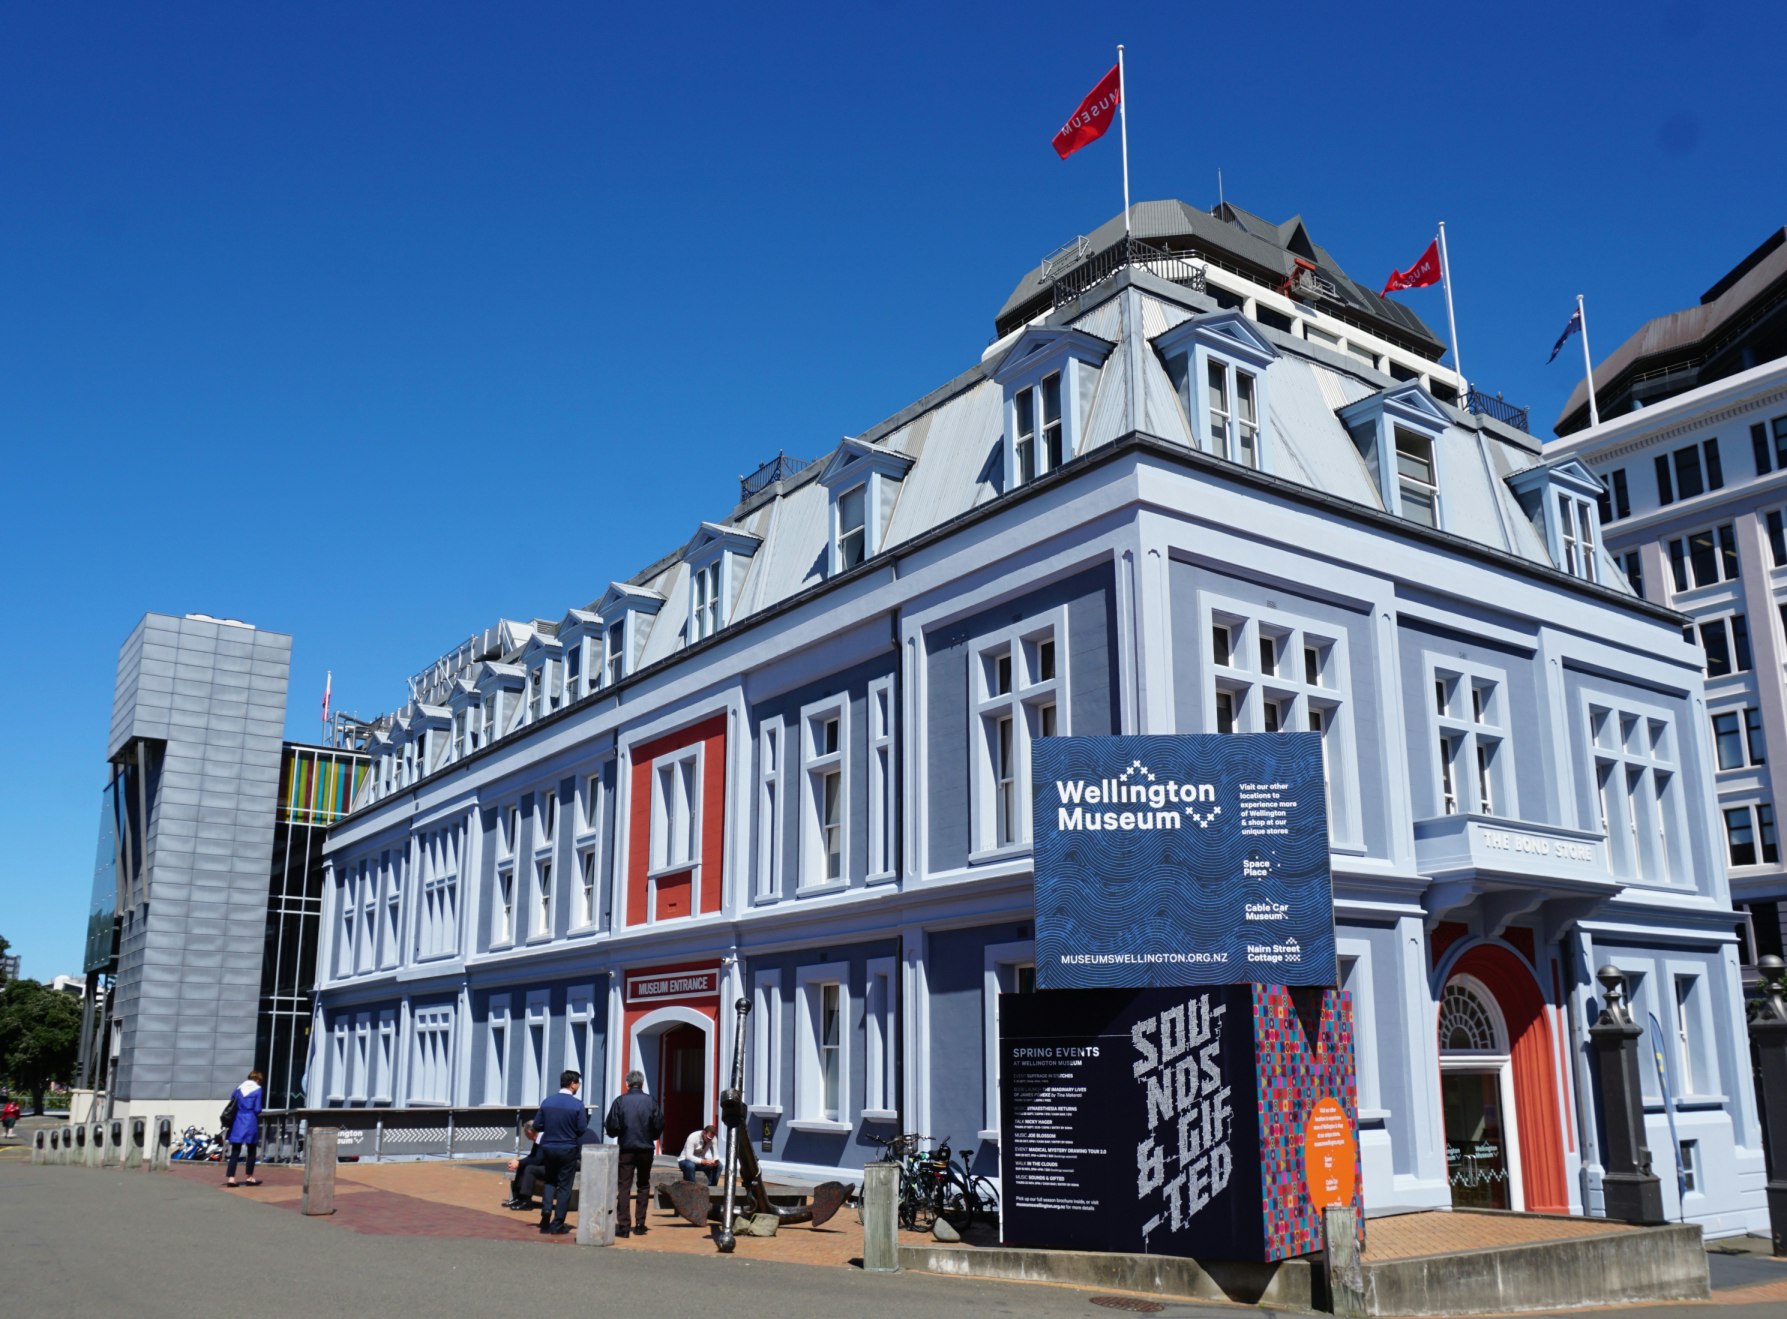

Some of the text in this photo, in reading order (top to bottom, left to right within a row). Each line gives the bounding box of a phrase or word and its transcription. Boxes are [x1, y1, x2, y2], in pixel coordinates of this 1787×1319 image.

[1056, 779, 1215, 808] Wellington
[1240, 801, 1278, 809] experience
[1250, 810, 1287, 818] Wellington
[1058, 807, 1181, 831] Museum
[1248, 819, 1265, 827] shop
[1241, 828, 1265, 836] unique
[1484, 832, 1592, 862] THE BOND STORE
[1243, 860, 1270, 869] Space
[1243, 868, 1268, 876] Place
[1245, 903, 1289, 912] Cable Car
[1245, 912, 1282, 920] Museum
[1247, 944, 1300, 954] Nairn Street
[1060, 952, 1228, 965] MUSEUMSWELLINGTON.ORG.NZ
[1247, 953, 1283, 963] Cottage
[638, 976, 708, 995] MUSEUM ENTRANCE
[1013, 1046, 1100, 1058] SPRING EVENTS
